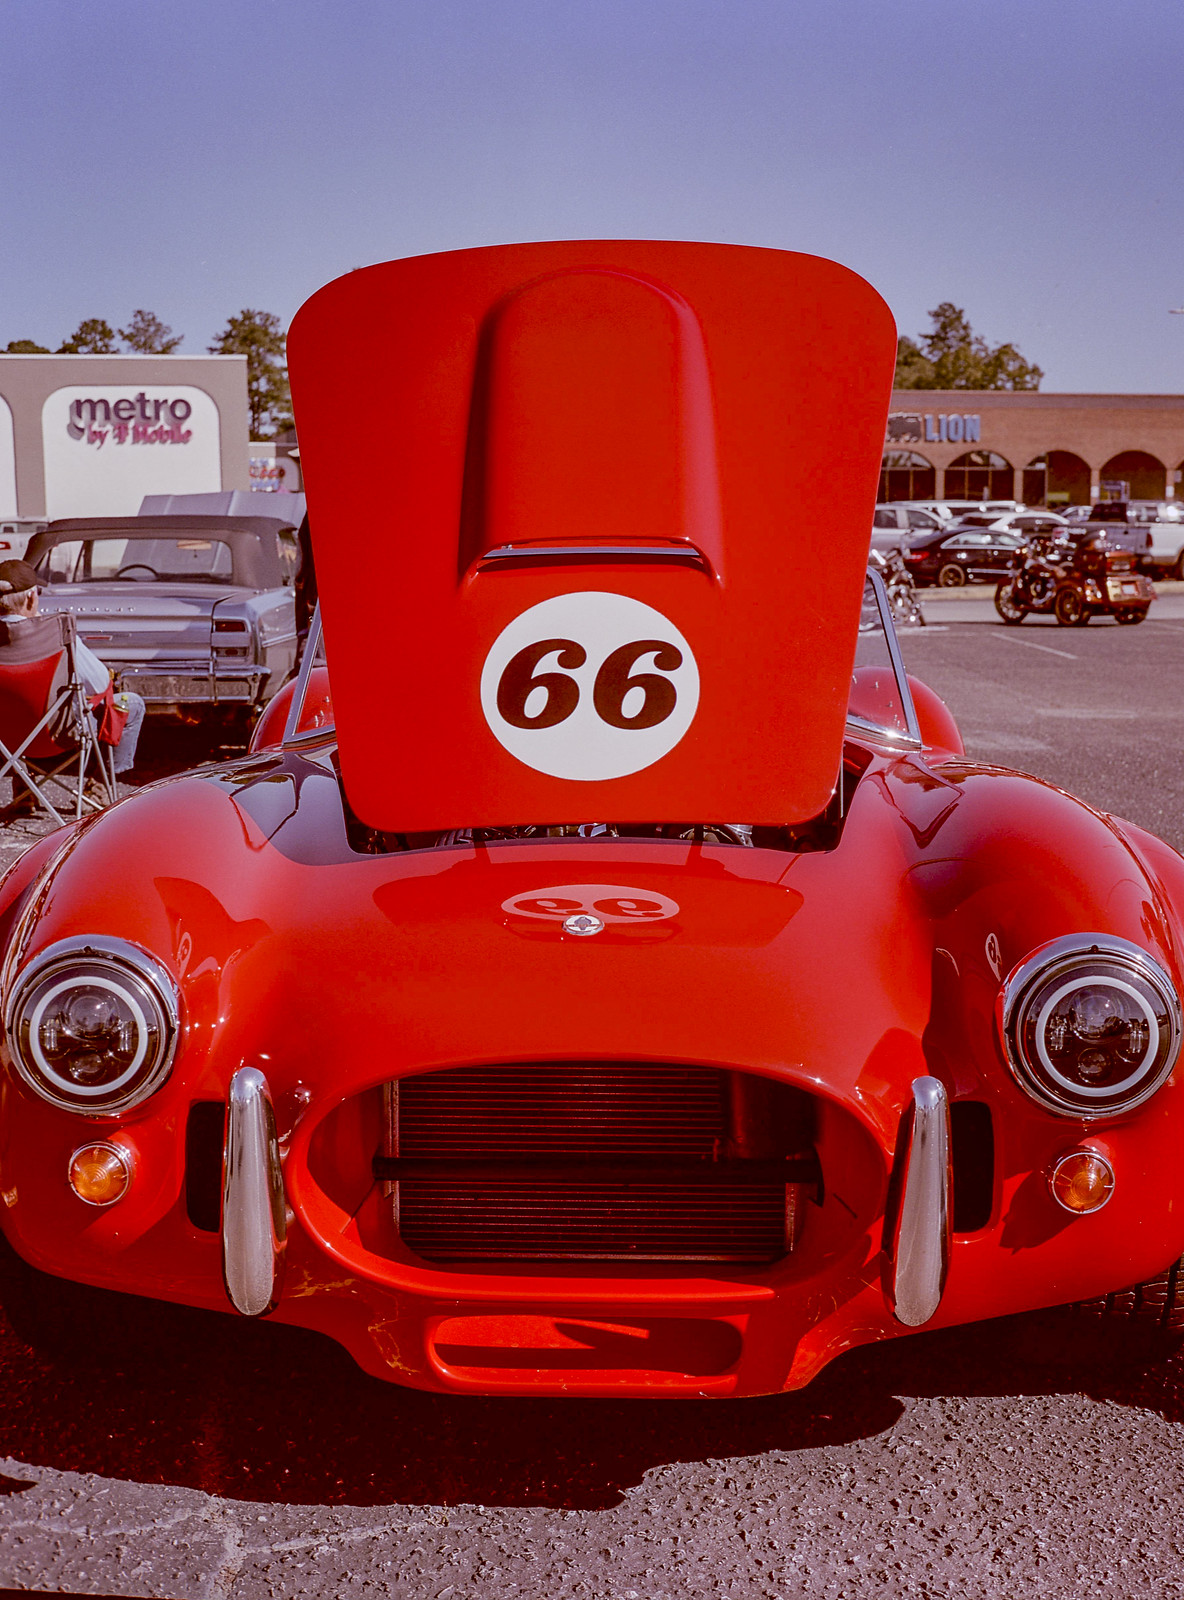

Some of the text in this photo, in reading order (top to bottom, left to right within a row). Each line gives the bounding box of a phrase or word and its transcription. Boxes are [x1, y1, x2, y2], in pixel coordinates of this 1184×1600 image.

[69, 391, 193, 428] metro
[87, 424, 109, 450] by
[924, 413, 981, 442] LION
[496, 638, 683, 730] 66
